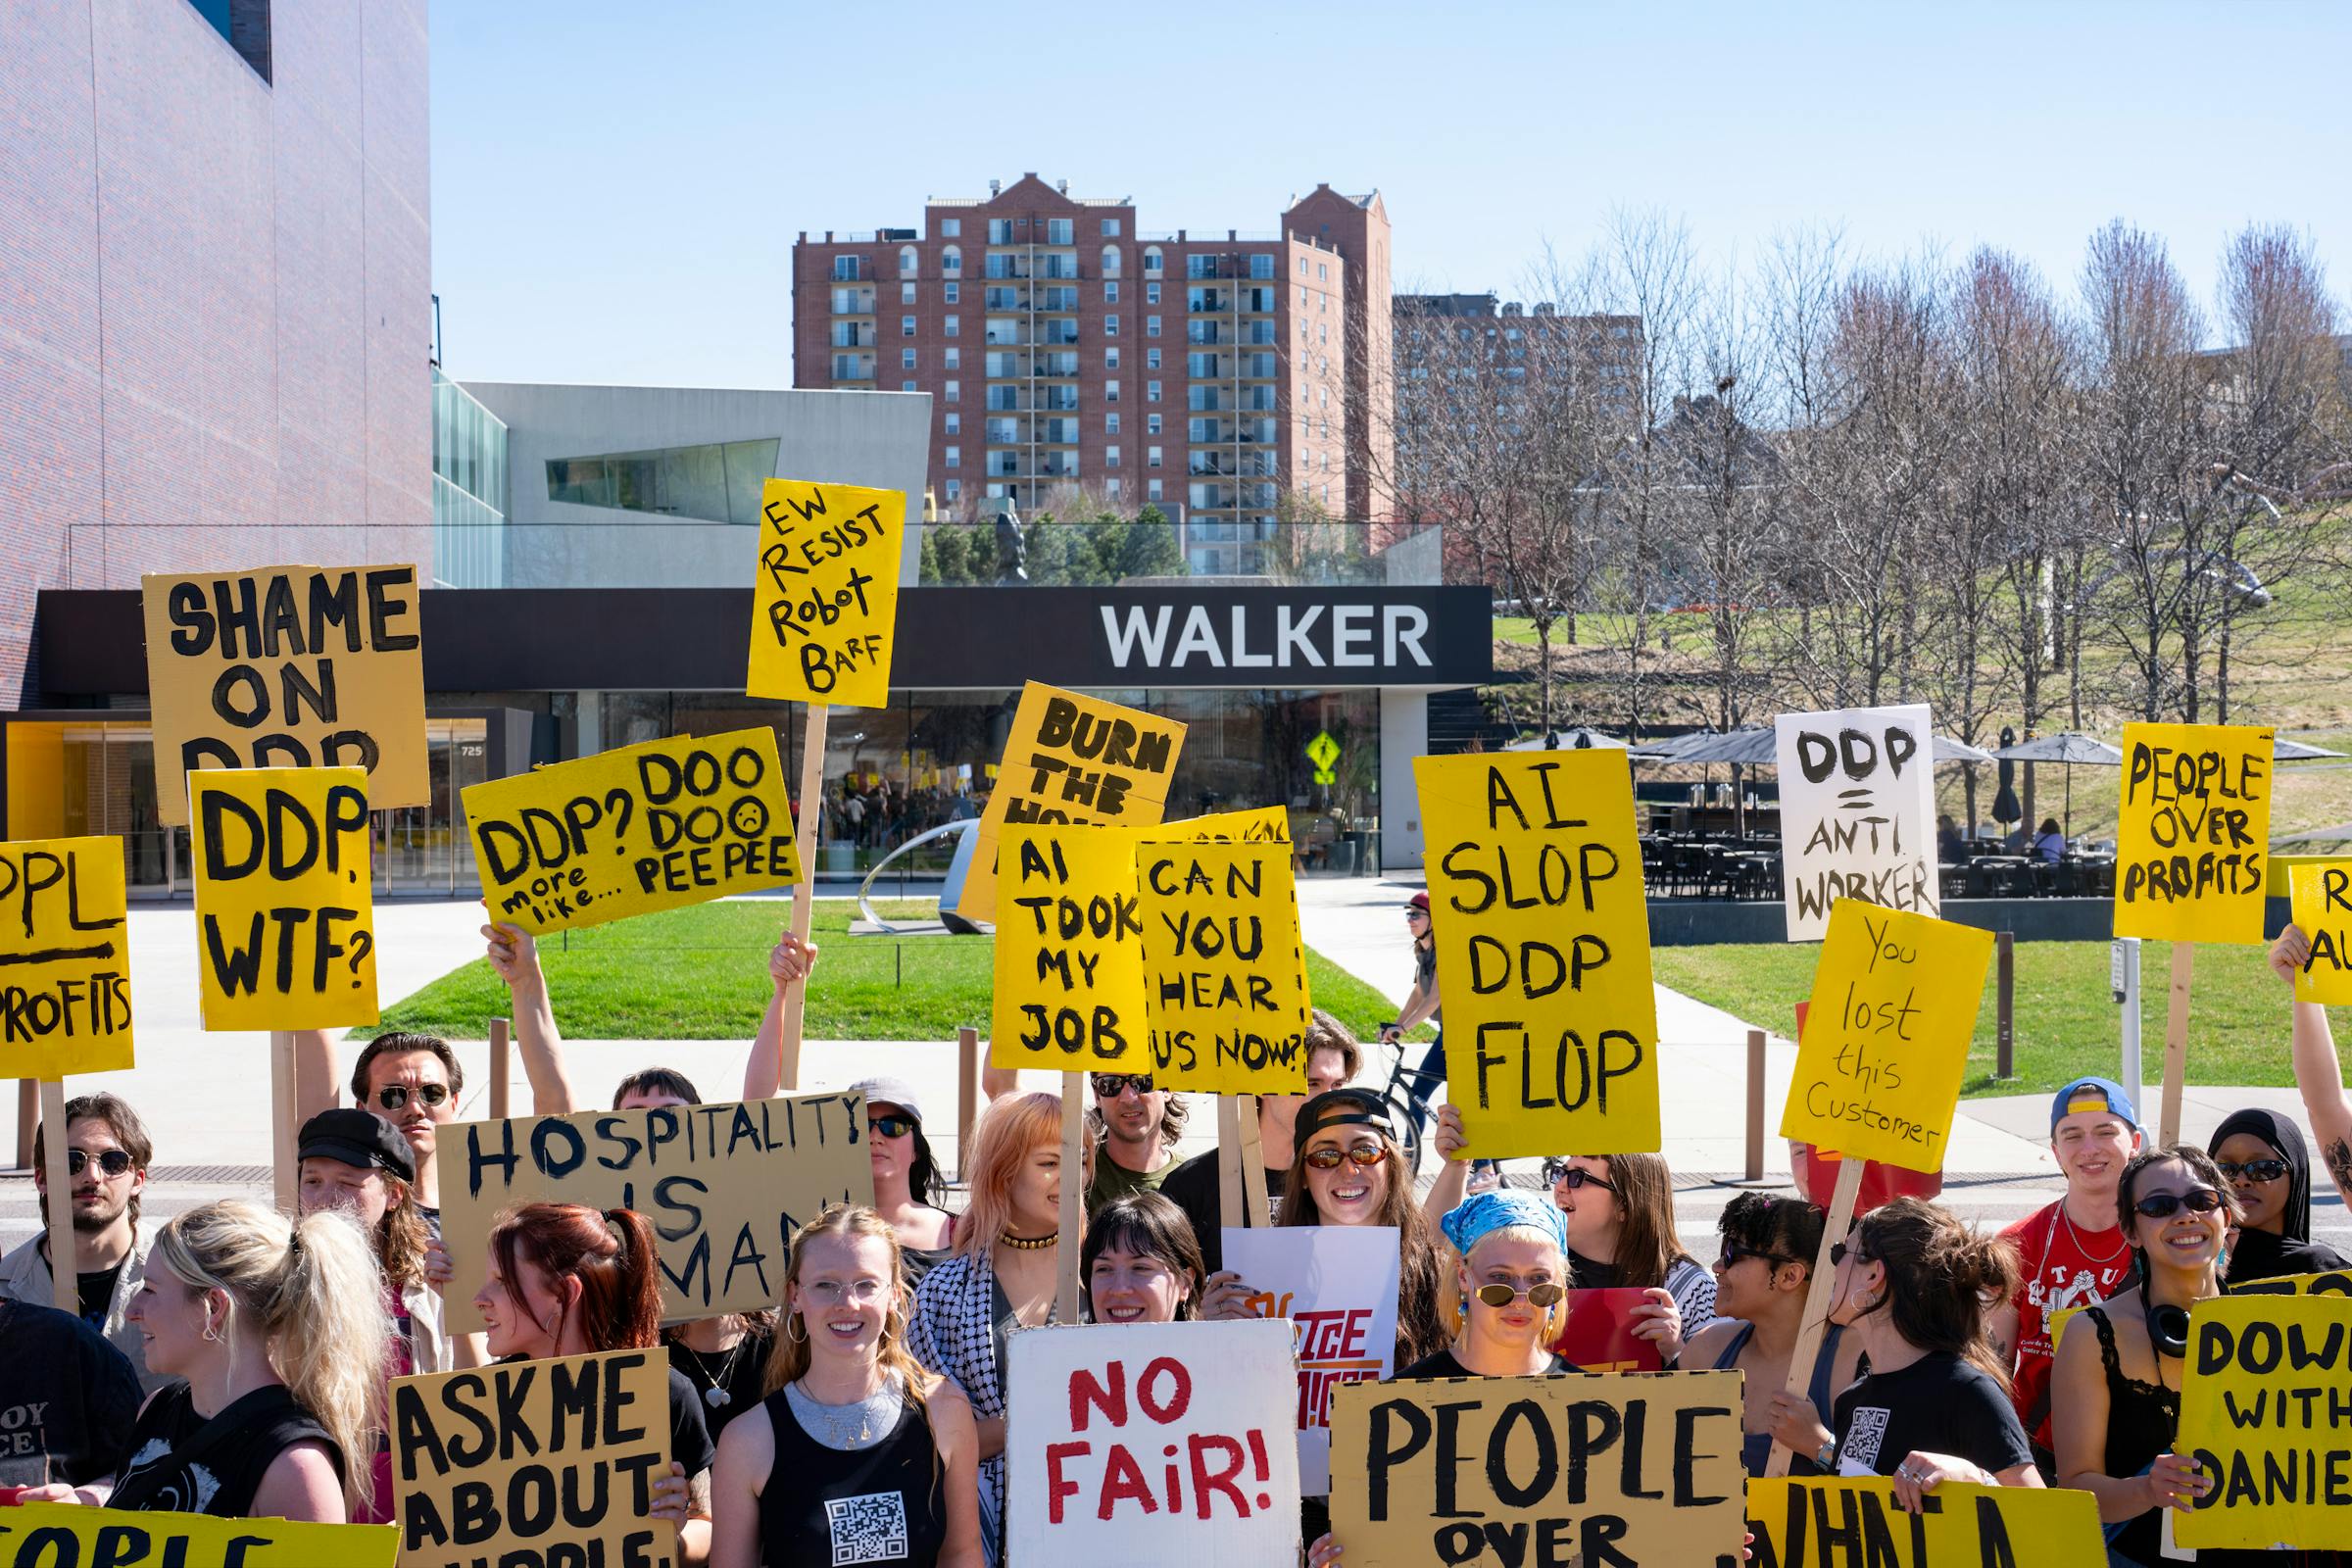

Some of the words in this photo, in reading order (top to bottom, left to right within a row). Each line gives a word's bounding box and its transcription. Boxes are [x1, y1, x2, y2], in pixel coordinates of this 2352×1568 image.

[763, 486, 828, 537] EW
[760, 503, 886, 595] RESIST
[169, 567, 420, 660] SHAME
[768, 566, 874, 648] Robot
[1100, 605, 1434, 668] WALKER
[212, 659, 338, 729] ON
[800, 635, 884, 695] BARF
[461, 745, 483, 758] 725
[1036, 696, 1173, 774] BURN
[1796, 726, 1918, 784] DDP
[637, 746, 764, 806] DOO
[1029, 753, 1133, 816] THE
[1485, 761, 1588, 831] AI
[2128, 741, 2266, 807] PEOPLE
[476, 787, 634, 887] DDP?
[2150, 802, 2255, 850] OVER
[501, 865, 588, 915] more
[1020, 838, 1069, 885] AI
[1149, 858, 1263, 899] CAN
[1441, 841, 1620, 914] SLOP
[1795, 855, 1940, 921] WORKER
[1012, 892, 1142, 942] TOOK
[1160, 909, 1264, 963] YOU
[1863, 915, 1917, 973] You
[203, 906, 373, 1000] WTF?
[1036, 946, 1100, 991] MY
[1469, 934, 1612, 1000] DDP
[0, 971, 132, 1044] ROFITS
[1159, 971, 1280, 1011] HEAR
[1842, 981, 1922, 1041] lost
[1019, 1003, 1128, 1059] JOB
[1152, 1029, 1198, 1073] US
[1214, 1027, 1301, 1073] NOW?
[1476, 1020, 1643, 1116] FLOP
[1833, 1043, 1901, 1092] this
[1806, 1081, 1941, 1148] Customer
[467, 1095, 861, 1201] HOSPITALITY
[2197, 1320, 2352, 1376] DOW
[395, 1372, 541, 1482] ASK
[549, 1353, 647, 1453] ME
[1068, 1356, 1193, 1433] NO
[2223, 1387, 2352, 1429] WITH
[1368, 1397, 1732, 1522] PEOPLE
[405, 1451, 662, 1551] ABOUT
[1434, 1514, 1639, 1568] OVER
